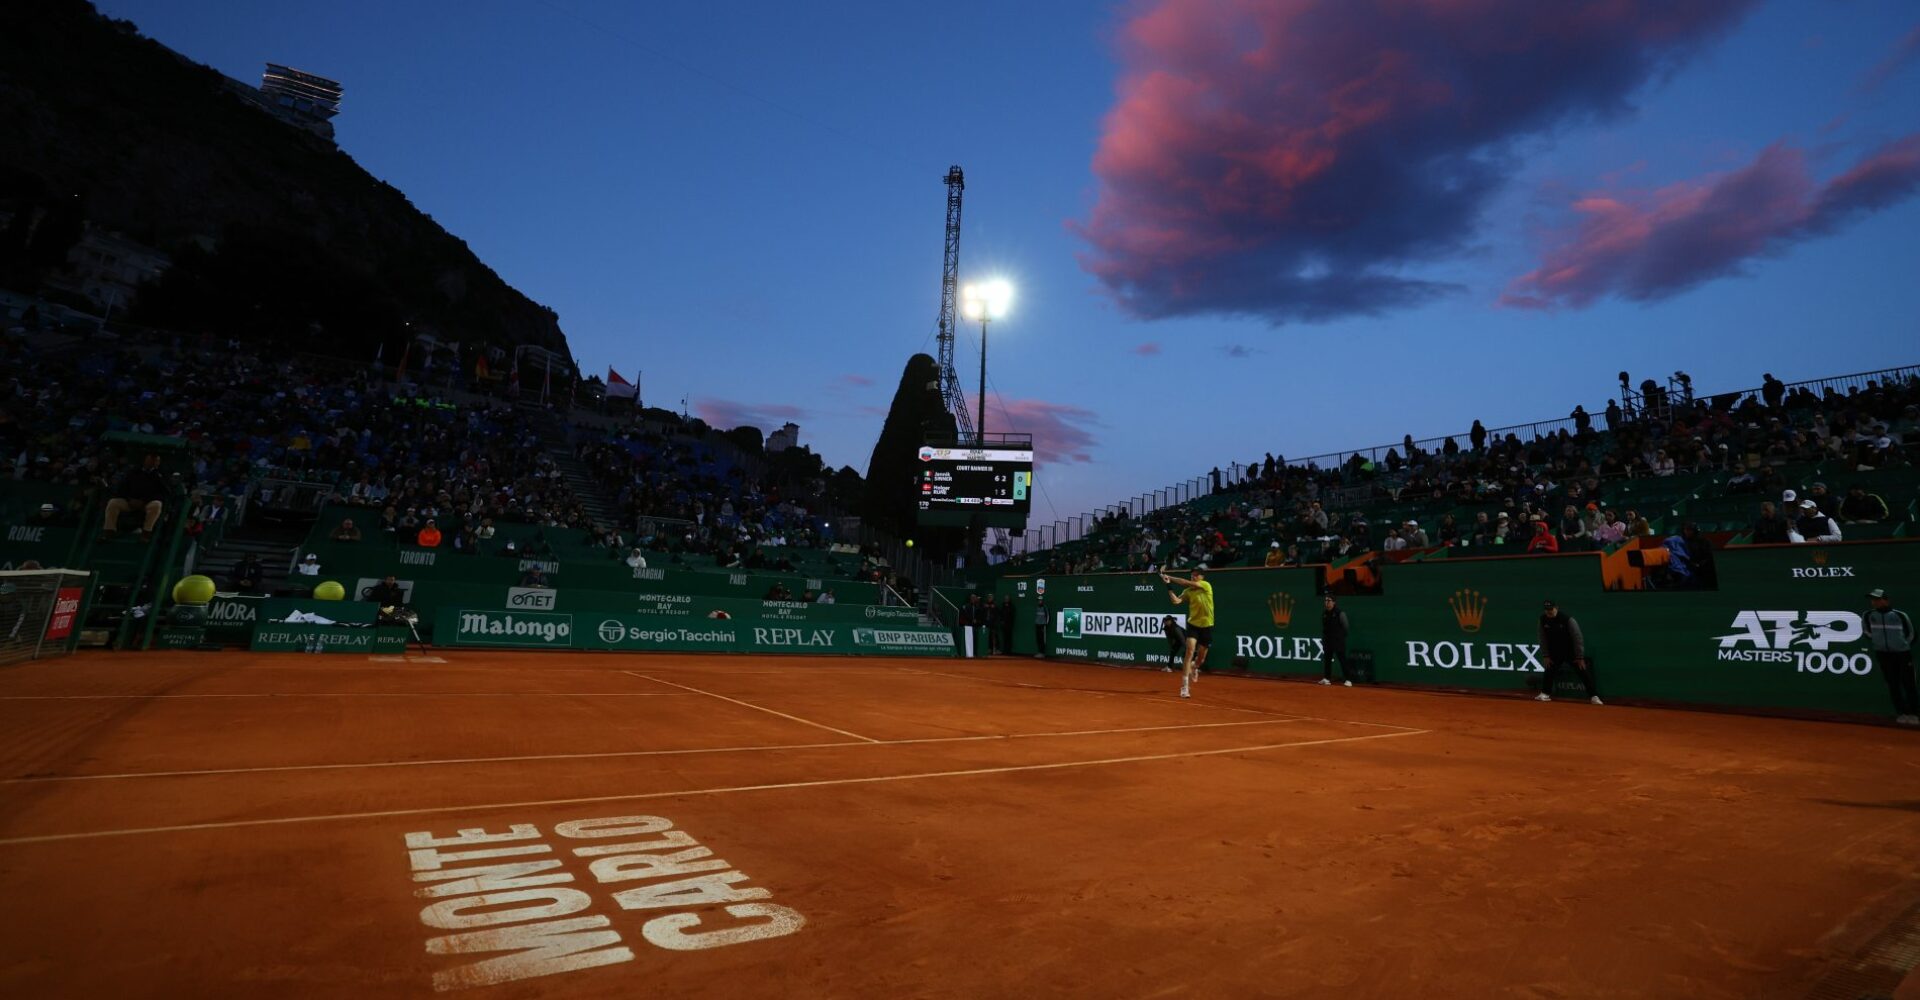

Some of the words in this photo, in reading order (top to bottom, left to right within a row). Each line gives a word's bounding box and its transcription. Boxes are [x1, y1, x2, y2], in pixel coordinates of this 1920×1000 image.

[8, 525, 46, 543] ROME
[399, 550, 436, 566] TORONTO
[632, 567, 665, 581] SHANGHAI
[729, 573, 748, 586] PARIS
[1792, 566, 1855, 578] ROLEX
[207, 601, 257, 622] MORA
[657, 602, 672, 610] BAY
[876, 610, 896, 618] Sergio
[460, 613, 570, 642] Malongo
[1085, 615, 1112, 632] BNP
[1116, 616, 1177, 635] PARIBA
[1710, 610, 1864, 651] ATP
[258, 632, 311, 644] REPLAY
[320, 634, 371, 646] REPLAY
[378, 636, 406, 645] REPLAY
[630, 627, 677, 642] Sergio
[678, 629, 736, 643] Tacchini
[753, 627, 836, 647] REPLAY
[878, 632, 901, 643] BNP
[904, 632, 949, 644] PARIBAS
[1056, 647, 1066, 655] BNP
[1066, 648, 1088, 656] PARIBAS
[1098, 650, 1108, 658] BNP
[1109, 651, 1135, 661] PARIBAS
[1236, 635, 1333, 662] ROLEX
[1717, 649, 1794, 663] MASTERS
[1146, 654, 1159, 662] BNP
[1404, 640, 1546, 673] ROLEX
[1793, 651, 1873, 676] 1000
[554, 815, 807, 951] CARLO
[404, 823, 636, 992] MONTE
